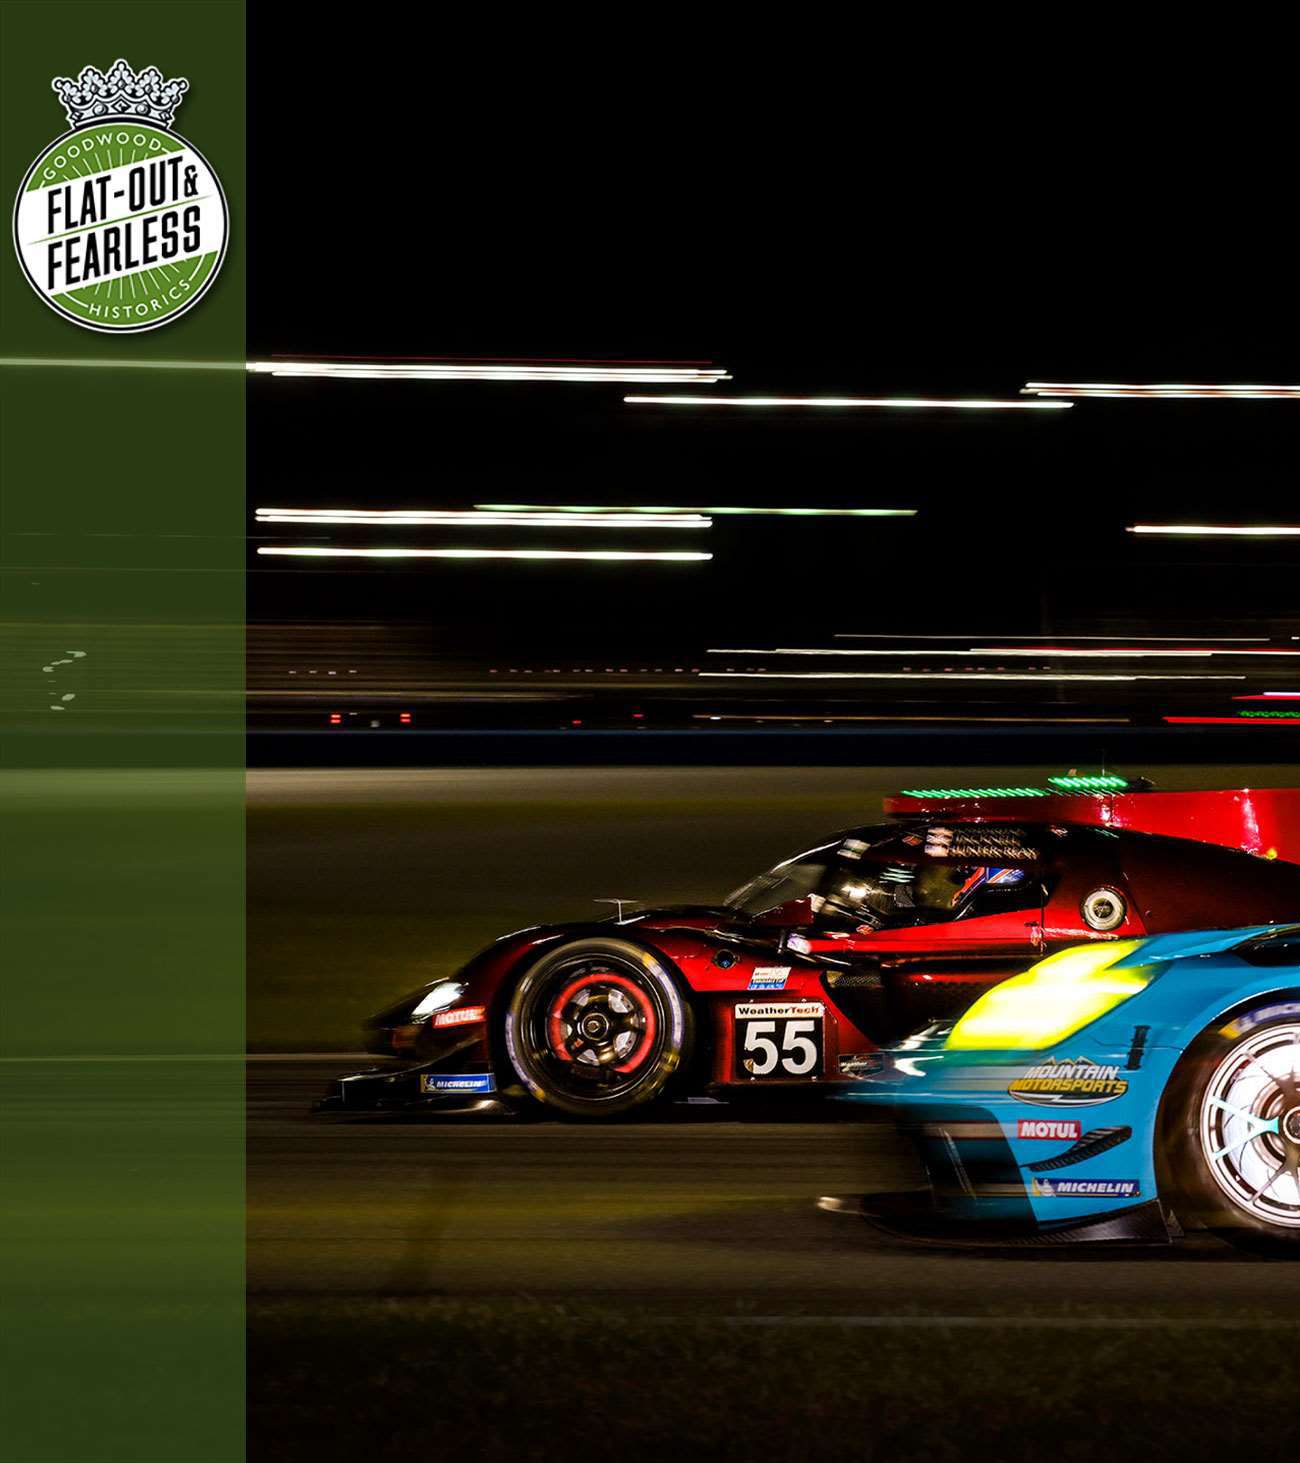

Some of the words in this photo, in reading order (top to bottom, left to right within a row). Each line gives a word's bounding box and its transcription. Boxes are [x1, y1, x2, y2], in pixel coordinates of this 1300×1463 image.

[738, 1005, 819, 1015] WeatherTech
[744, 1020, 817, 1074] 55
[1025, 1065, 1119, 1080] MOUNTAIN
[1009, 1079, 1128, 1094] MOTORSPORTS
[1021, 1122, 1078, 1138] MOTUL
[1057, 1182, 1134, 1193] MICHELIN
